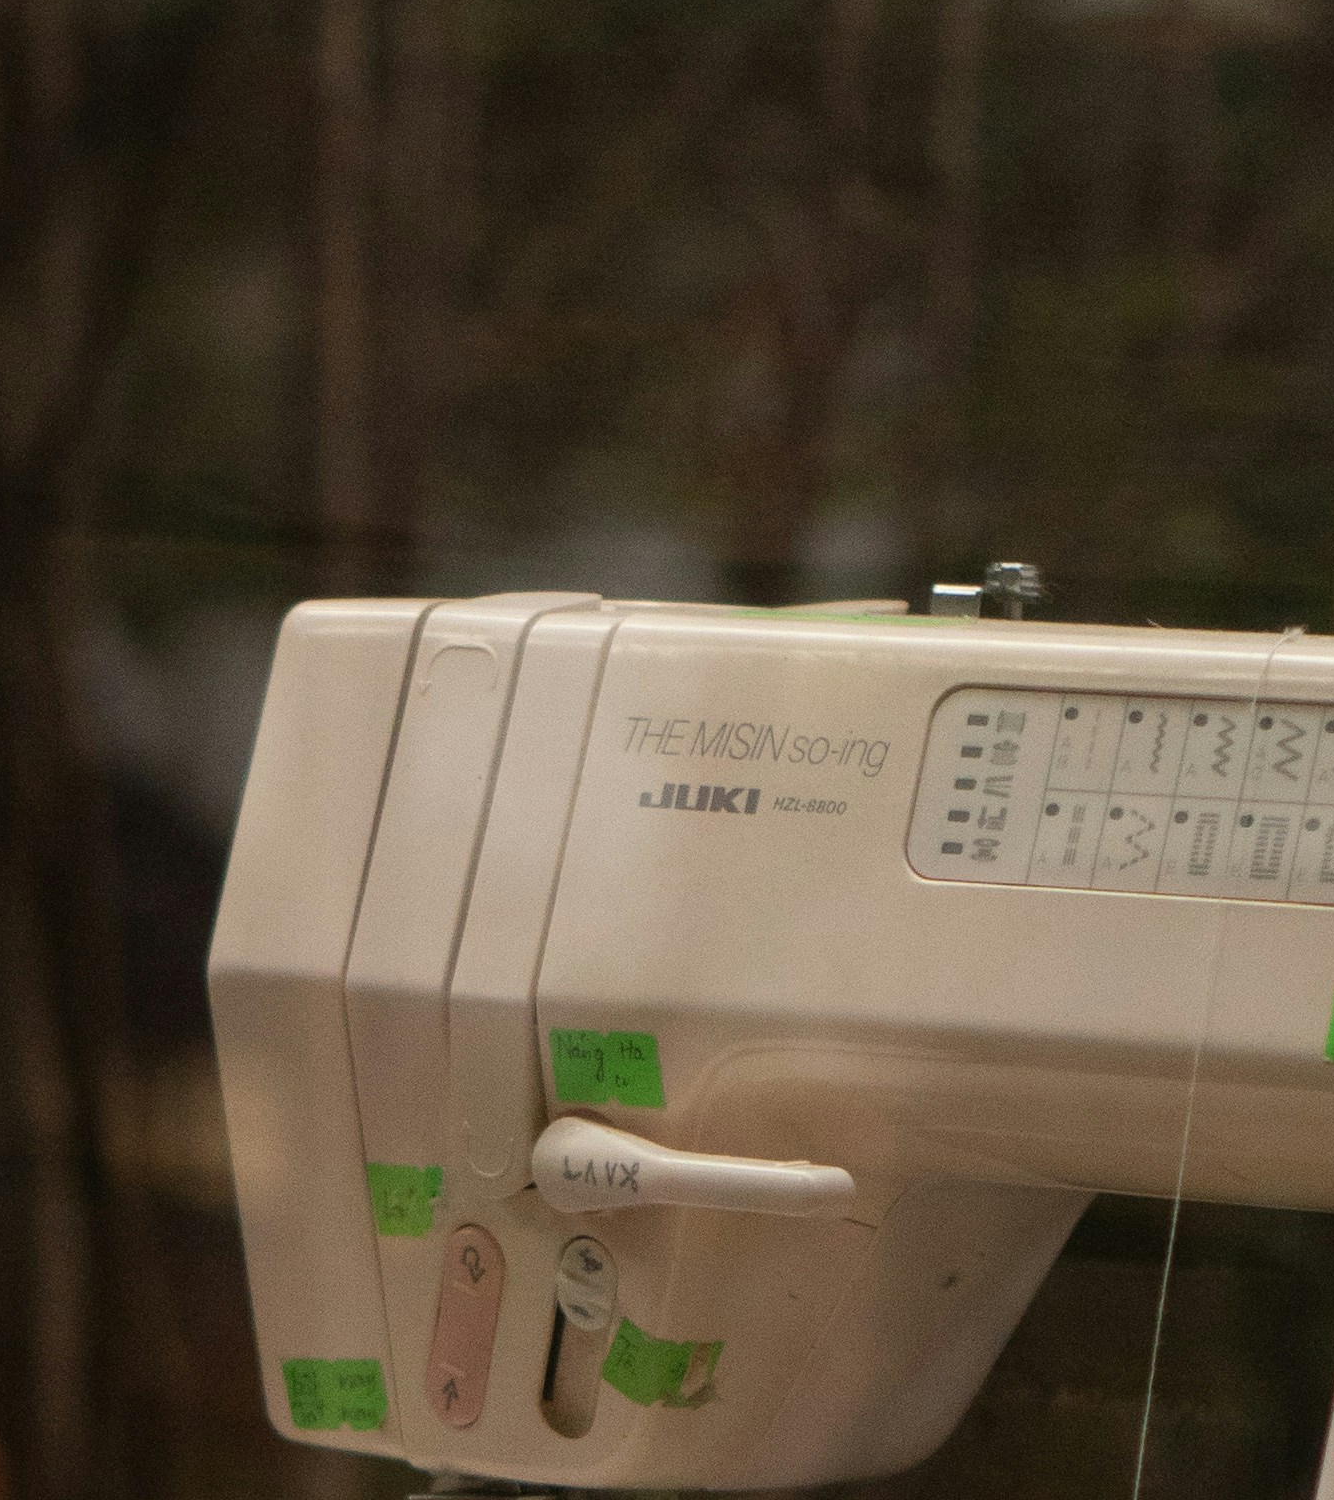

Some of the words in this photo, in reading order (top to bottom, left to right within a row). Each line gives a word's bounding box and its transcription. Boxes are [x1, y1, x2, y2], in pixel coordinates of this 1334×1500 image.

[624, 716, 690, 757] THE
[690, 719, 790, 763] MISIN
[788, 730, 891, 778] so-ing
[638, 782, 762, 816] JUKI
